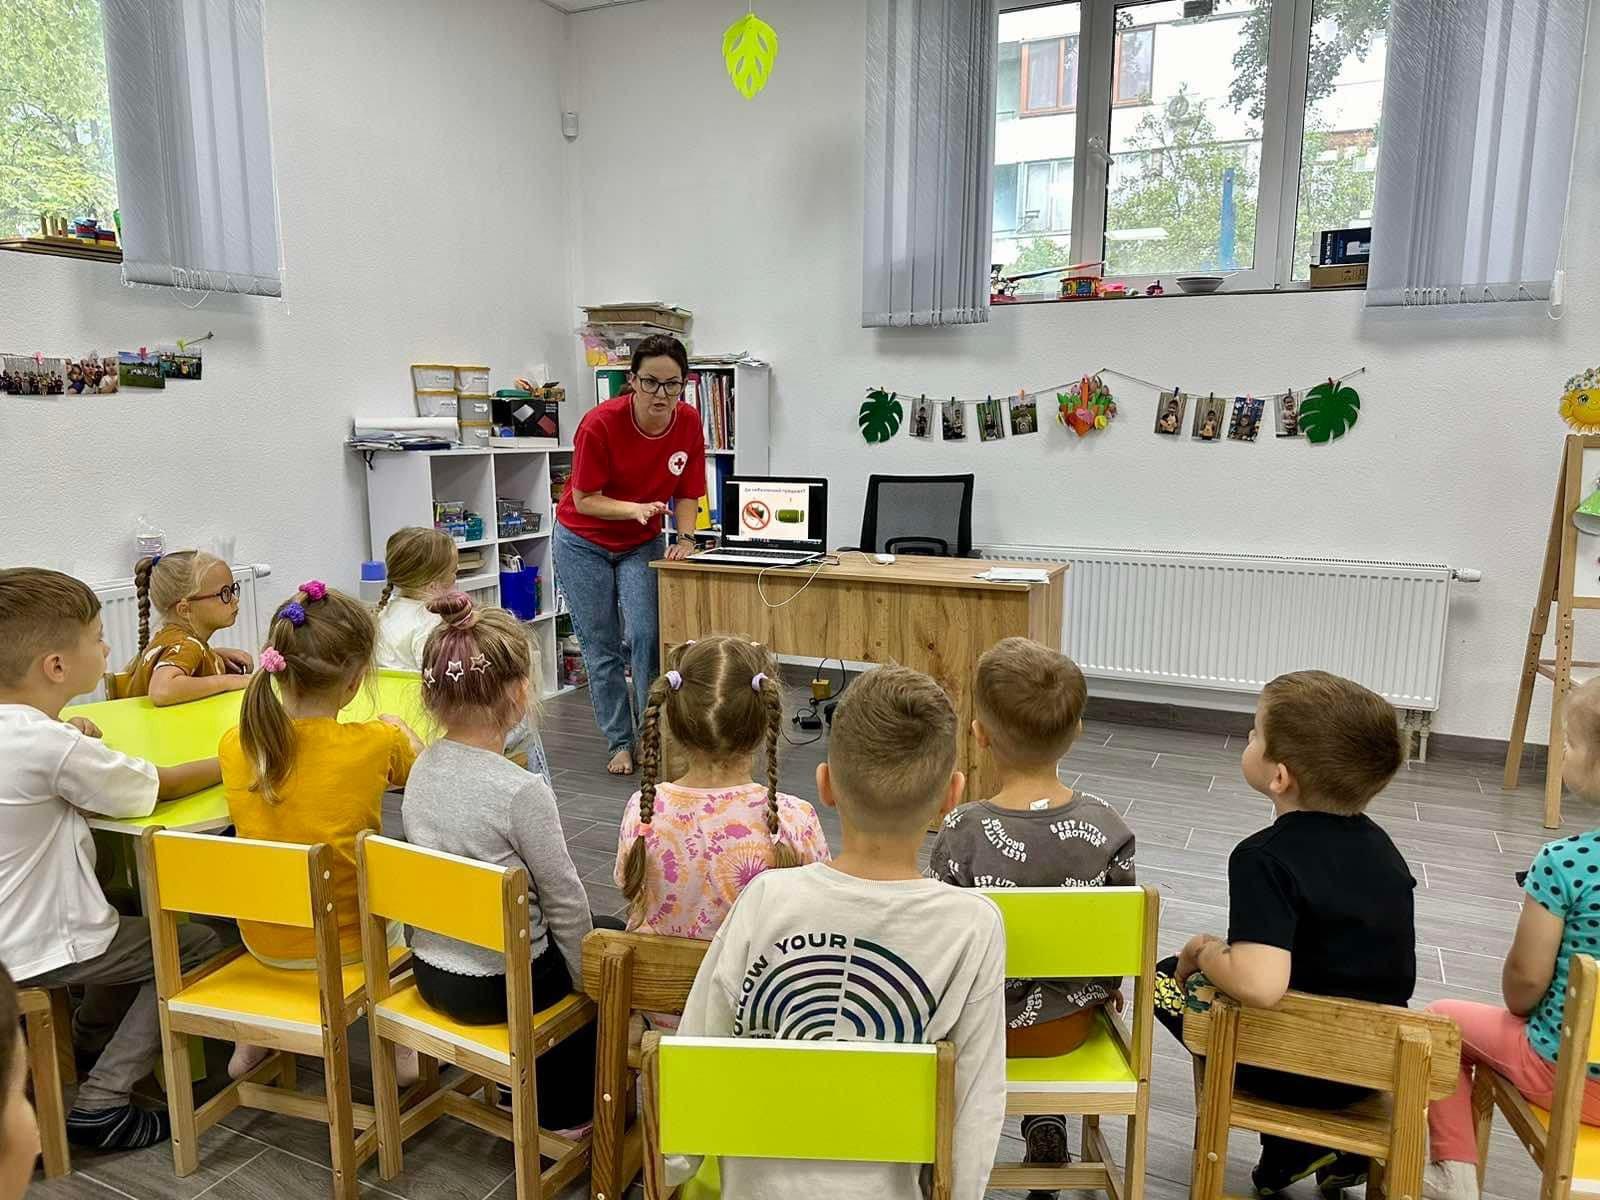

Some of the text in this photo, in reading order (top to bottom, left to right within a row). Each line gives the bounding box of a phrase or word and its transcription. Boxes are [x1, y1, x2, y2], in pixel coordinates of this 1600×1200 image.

[981, 817, 1004, 849] LITTLE
[991, 818, 1025, 852] BROTHER
[1049, 819, 1107, 844] BEST LITTLE
[1058, 829, 1101, 848] BROTHER
[1001, 846, 1027, 862] BEST
[974, 875, 993, 886] EST
[733, 933, 847, 1037] OLLOW YOUR
